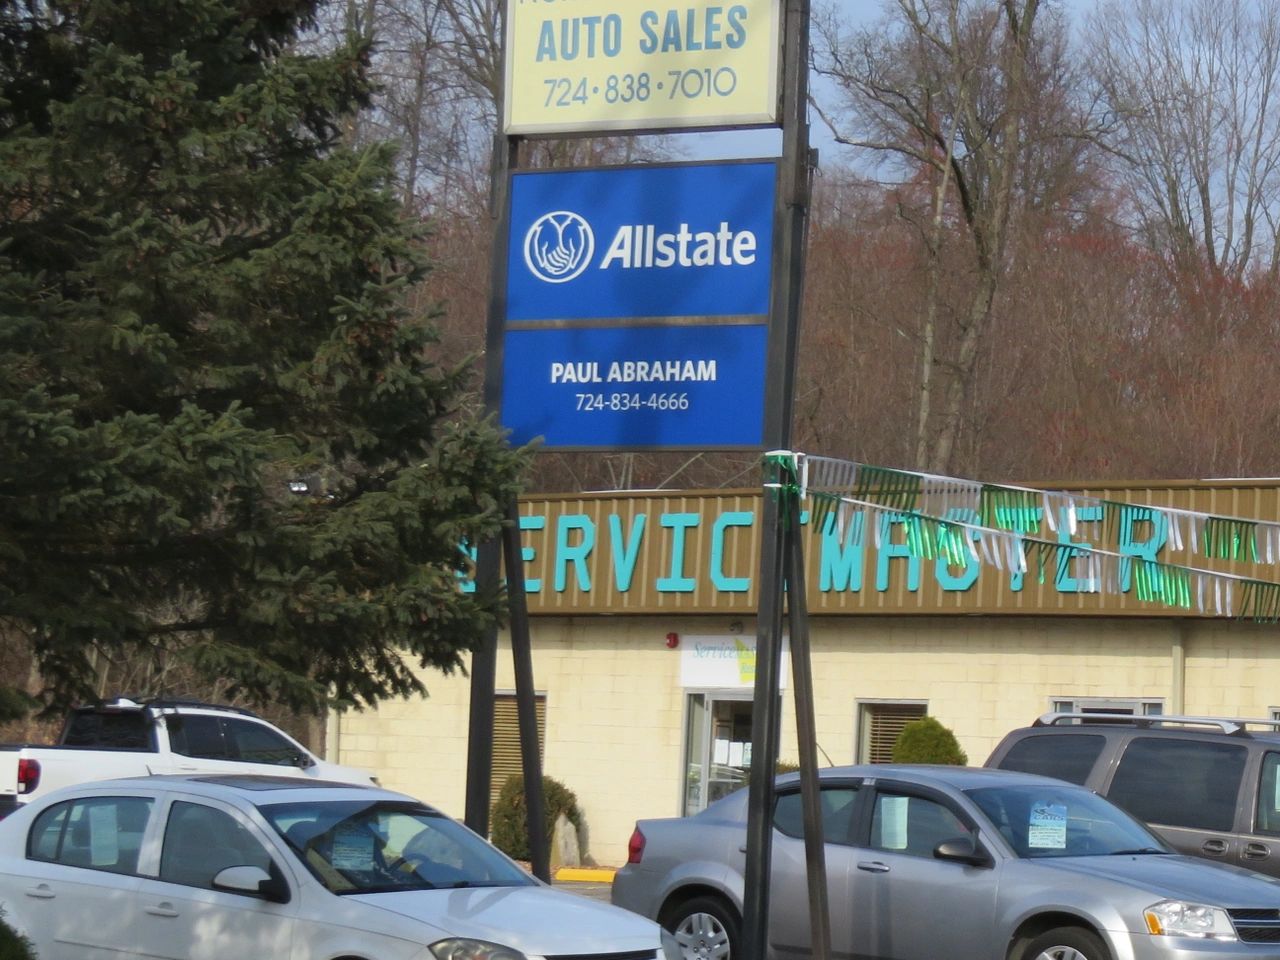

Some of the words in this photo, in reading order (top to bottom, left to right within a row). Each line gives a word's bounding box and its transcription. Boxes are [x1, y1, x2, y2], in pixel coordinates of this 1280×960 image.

[535, 13, 623, 63] AUTO
[639, 6, 749, 55] SALES
[599, 221, 757, 270] Allstate
[550, 361, 603, 384] PAUL
[607, 360, 717, 383] ABRAHAM
[575, 393, 689, 412] 724-834-4666
